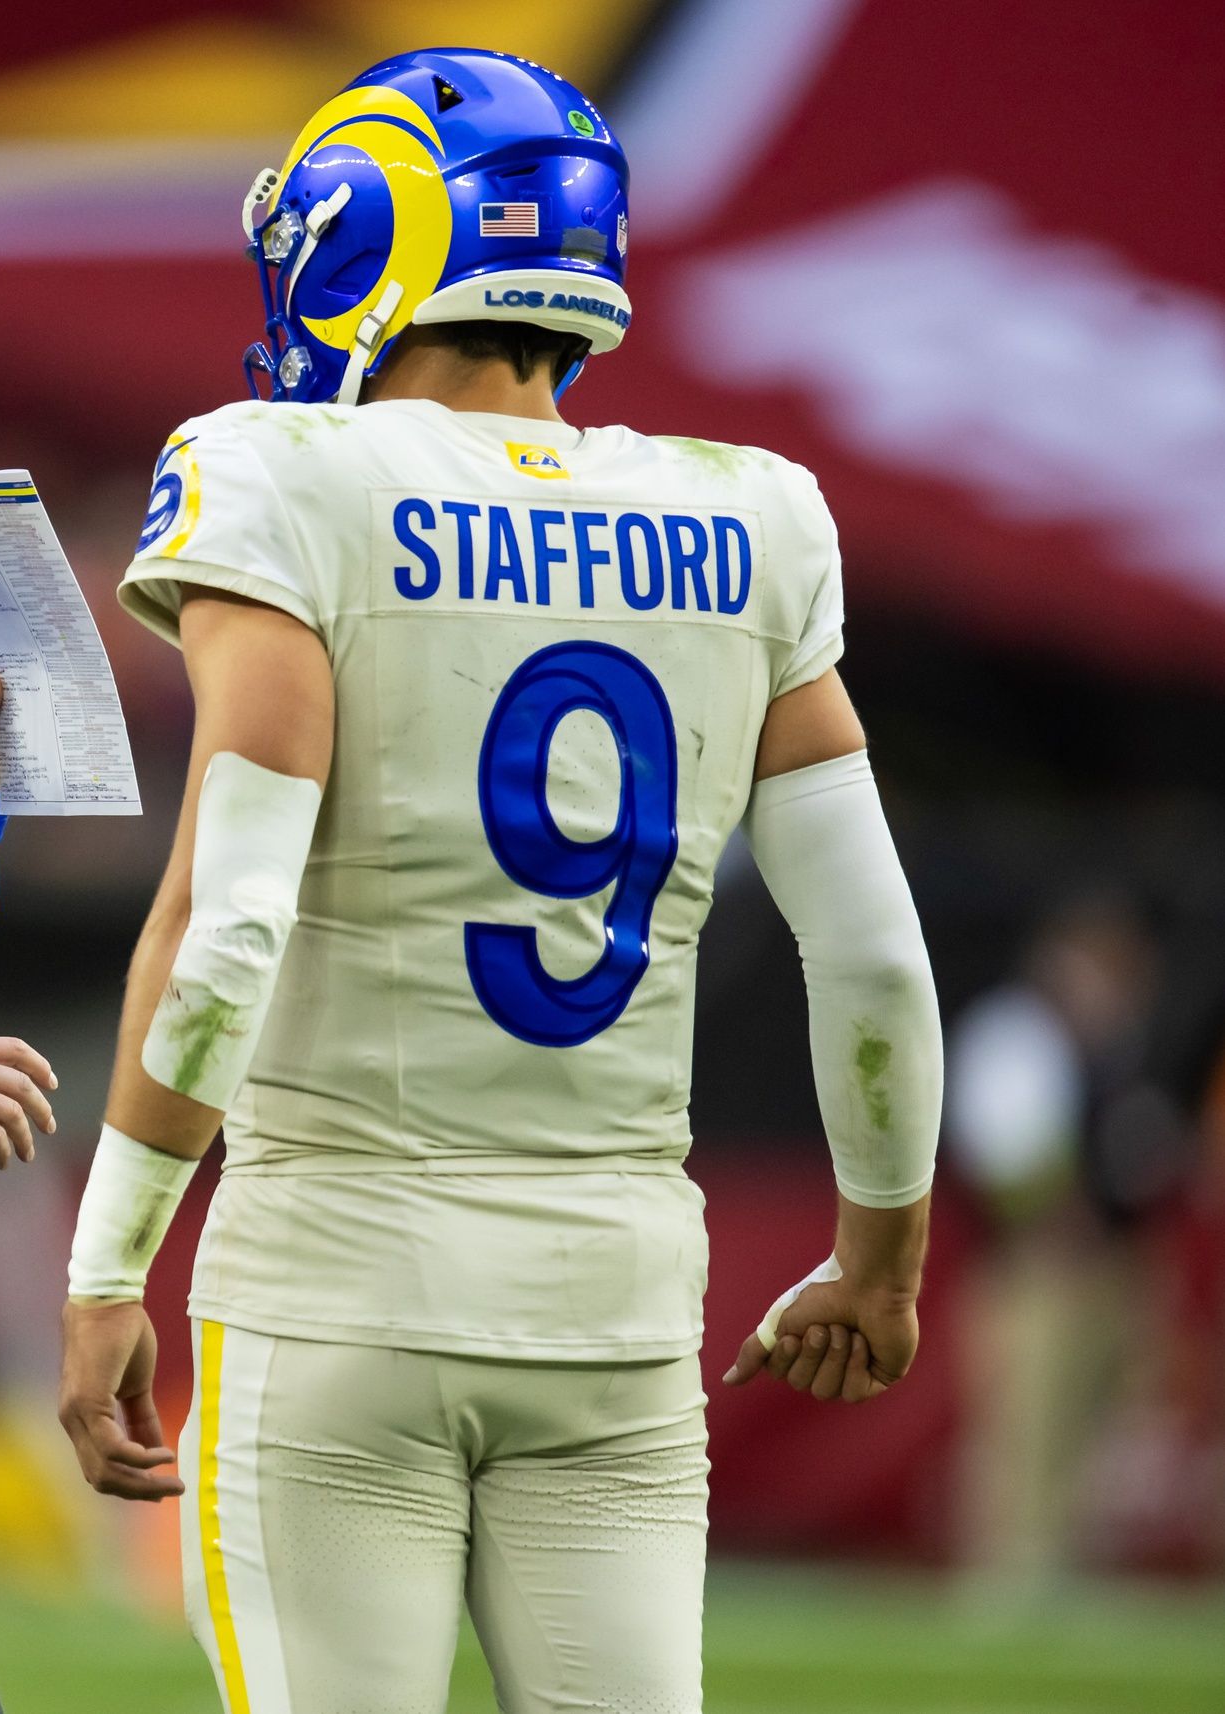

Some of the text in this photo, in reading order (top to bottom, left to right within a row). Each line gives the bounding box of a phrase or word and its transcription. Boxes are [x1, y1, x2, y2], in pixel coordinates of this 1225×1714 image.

[485, 290, 545, 308] LOS
[520, 450, 562, 469] LA
[393, 497, 752, 615] STAFFORD
[464, 640, 678, 1049] 9
